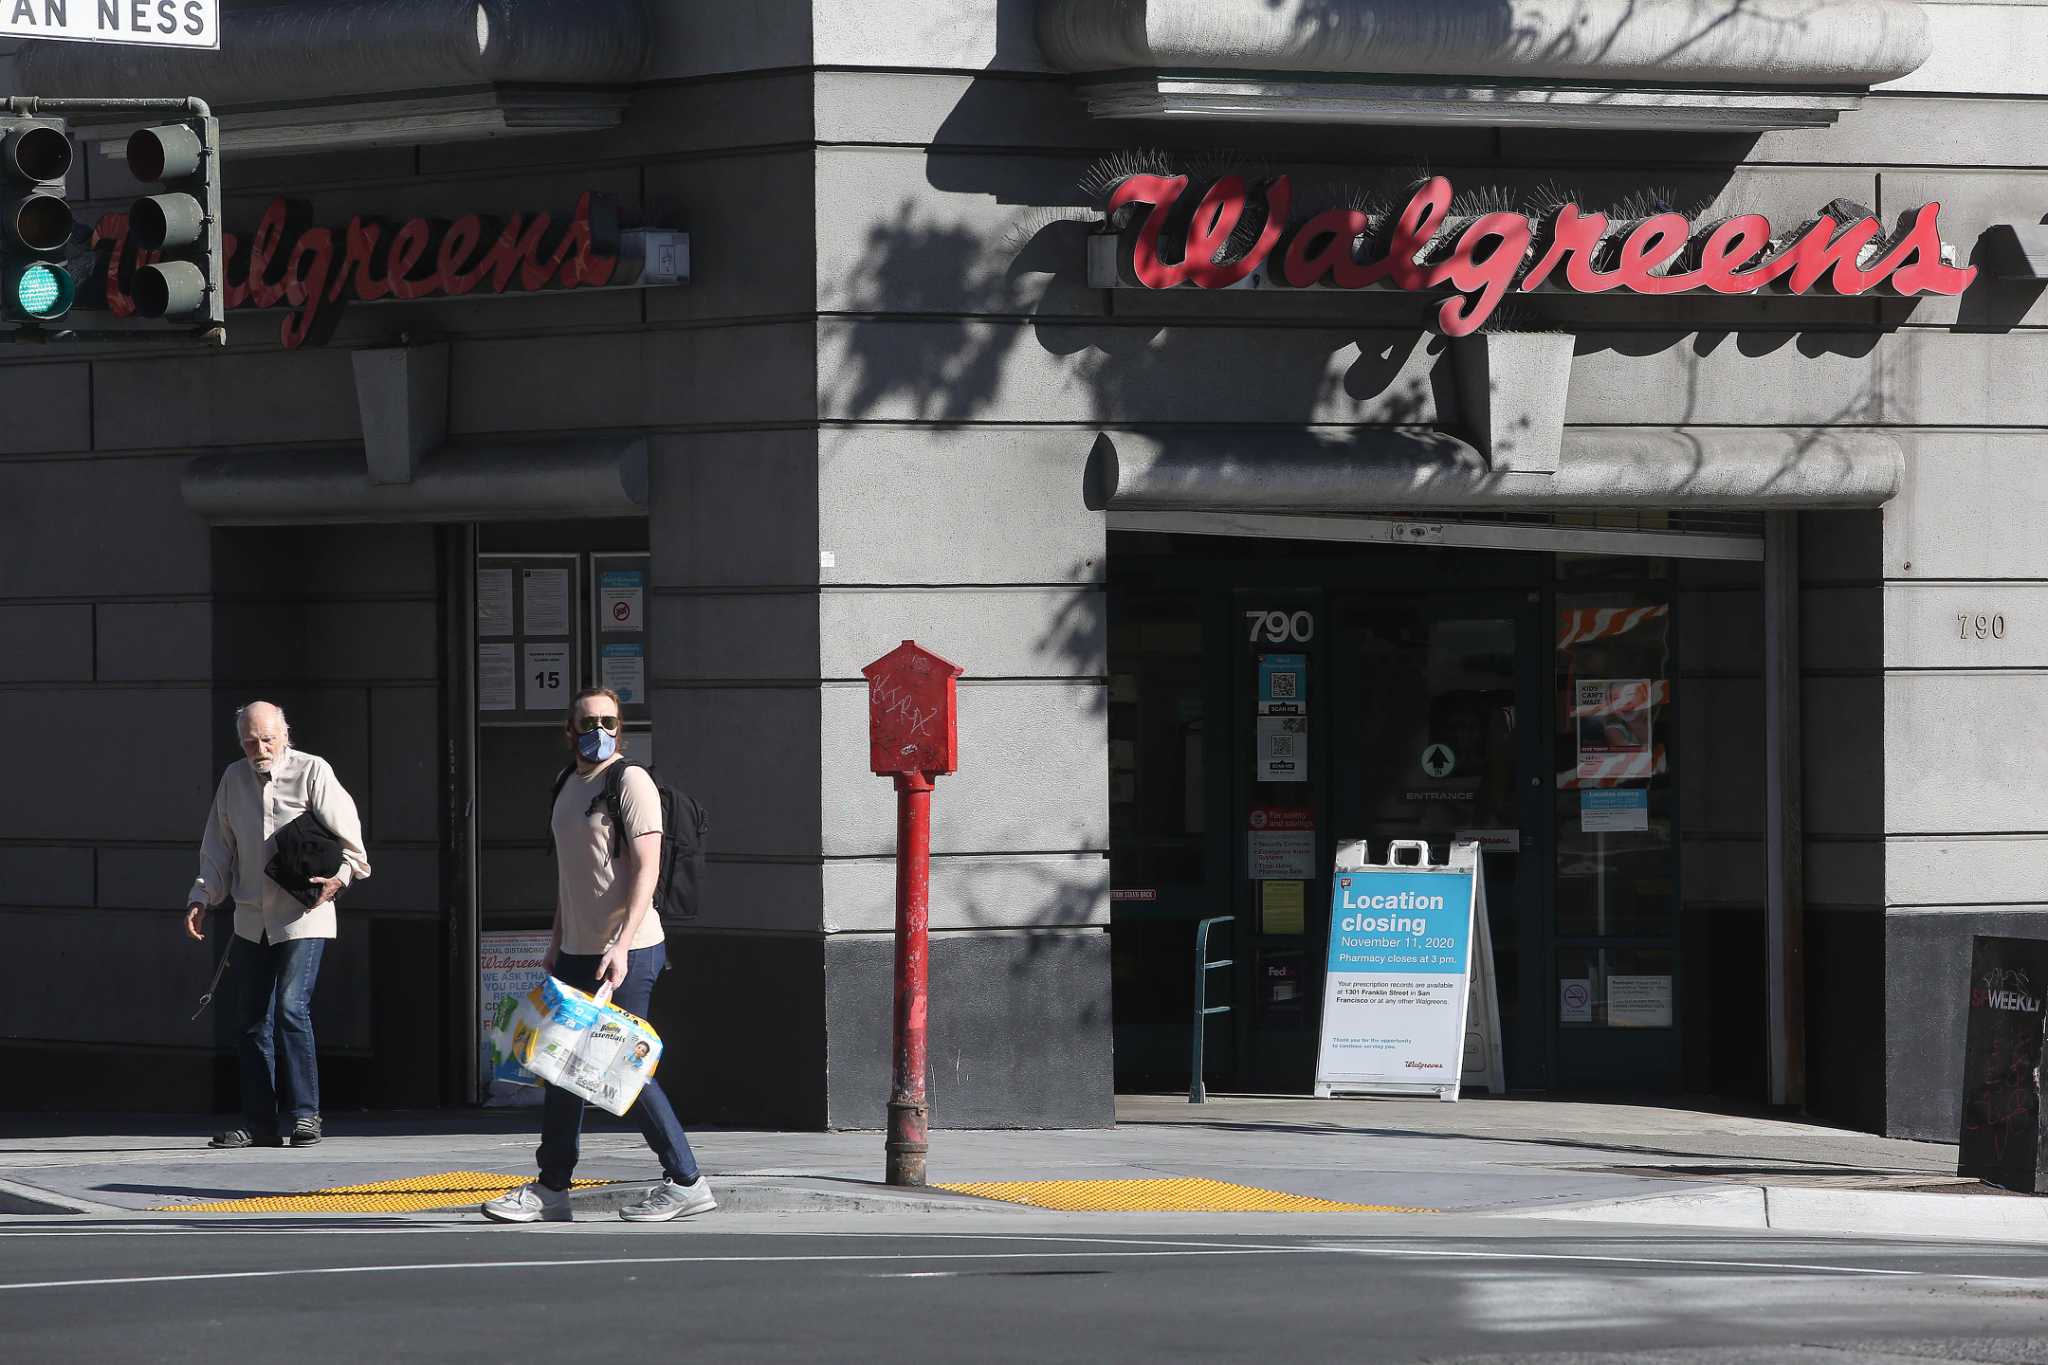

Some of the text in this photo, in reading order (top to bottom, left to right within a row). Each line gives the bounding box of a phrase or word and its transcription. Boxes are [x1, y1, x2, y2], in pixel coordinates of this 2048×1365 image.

[0, 0, 204, 36] AN NESS
[1104, 174, 1978, 337] Walgreens
[92, 193, 617, 349] lgreens
[1246, 610, 1314, 642] 790
[1957, 613, 2004, 640] 790
[535, 671, 560, 689] 15
[1406, 792, 1474, 800] ENTRANCE
[1343, 890, 1445, 910] Location
[1341, 913, 1427, 937] closing
[1340, 936, 1455, 949] November 11, 2020
[481, 954, 545, 974] Walgreen
[1339, 953, 1457, 966] Pharmacy closes at 3 pm.
[482, 973, 499, 982] WE
[502, 972, 522, 981] ASK
[485, 982, 506, 992] YOU
[1352, 981, 1389, 989] prescription
[1988, 989, 2041, 1012] WEEKLY
[590, 1030, 626, 1043] Essentials
